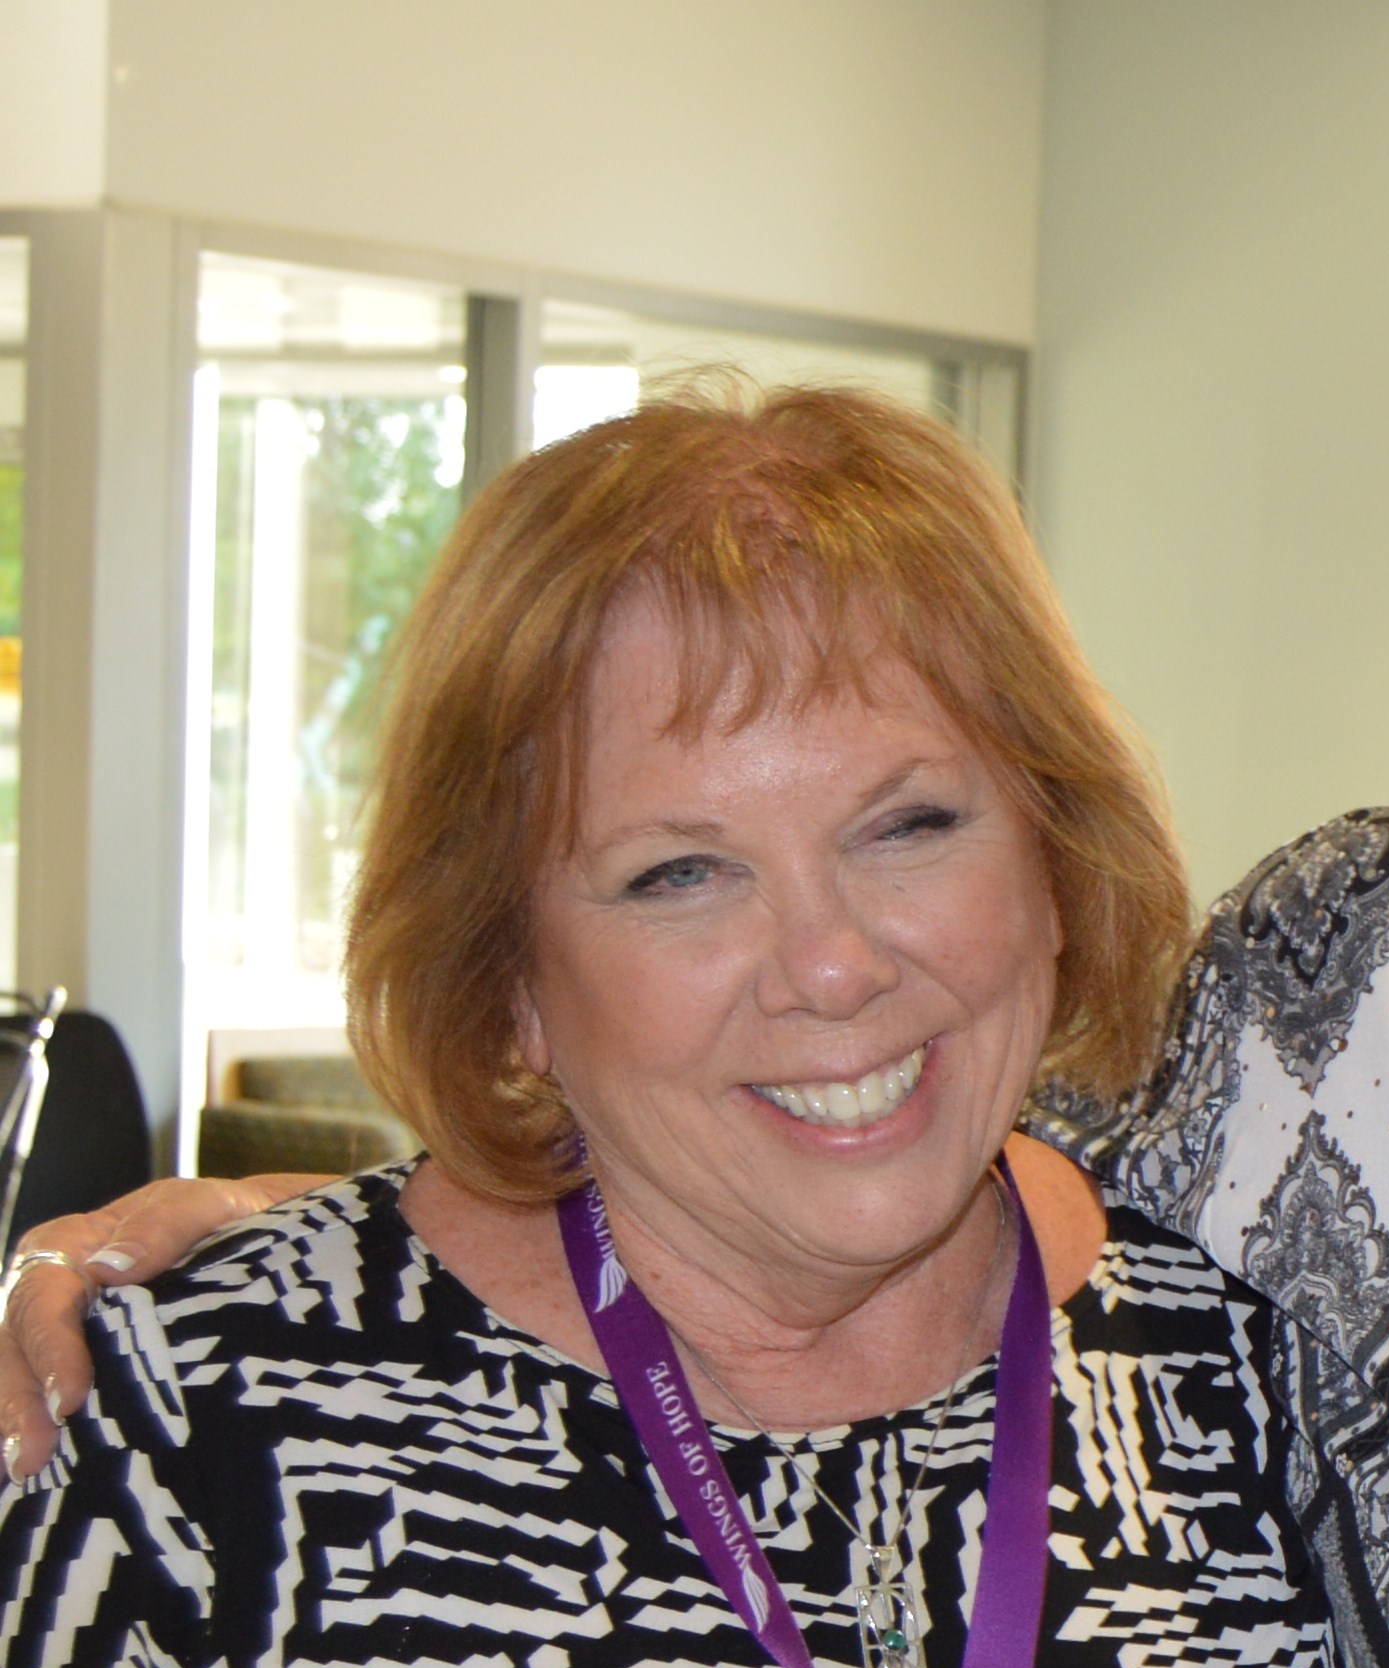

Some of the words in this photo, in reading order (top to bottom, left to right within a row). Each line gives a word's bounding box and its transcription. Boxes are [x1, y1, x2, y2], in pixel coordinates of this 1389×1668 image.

[646, 1361, 694, 1436] HOPE
[679, 1441, 708, 1476] OF
[699, 1479, 752, 1570] WINGS
